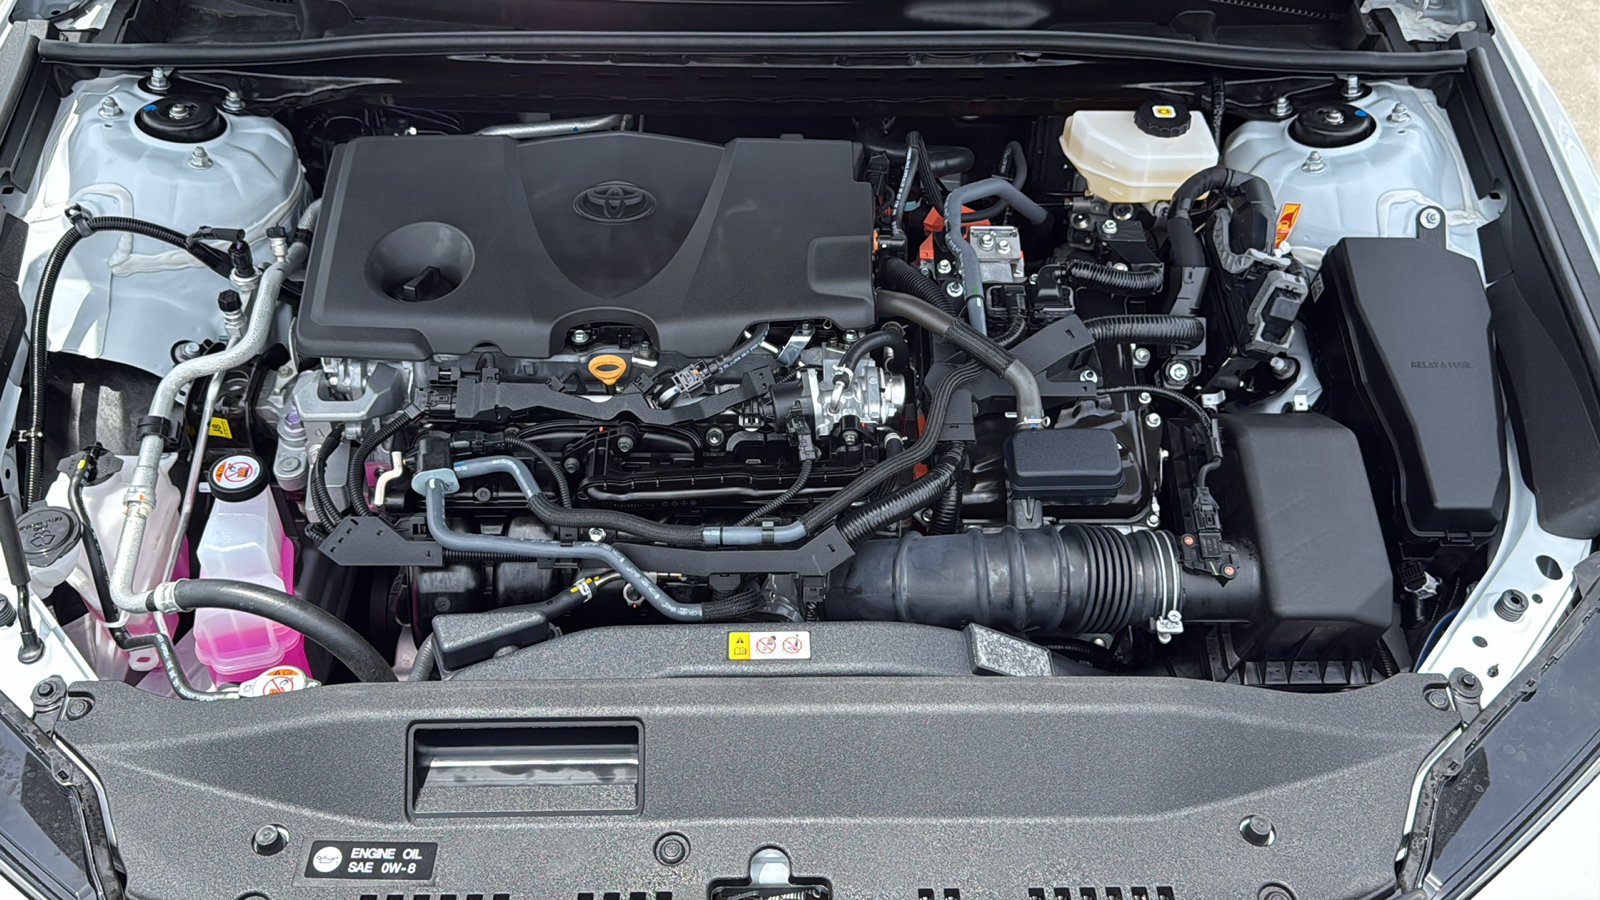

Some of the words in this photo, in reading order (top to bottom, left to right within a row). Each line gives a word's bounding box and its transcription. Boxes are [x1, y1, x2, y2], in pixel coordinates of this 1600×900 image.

[1410, 361, 1438, 369] RELAY
[1448, 361, 1471, 369] FUSE
[350, 848, 397, 860] ENGINE
[402, 848, 423, 860] OIL
[347, 861, 374, 873] SAE
[381, 862, 417, 874] 0W-8
